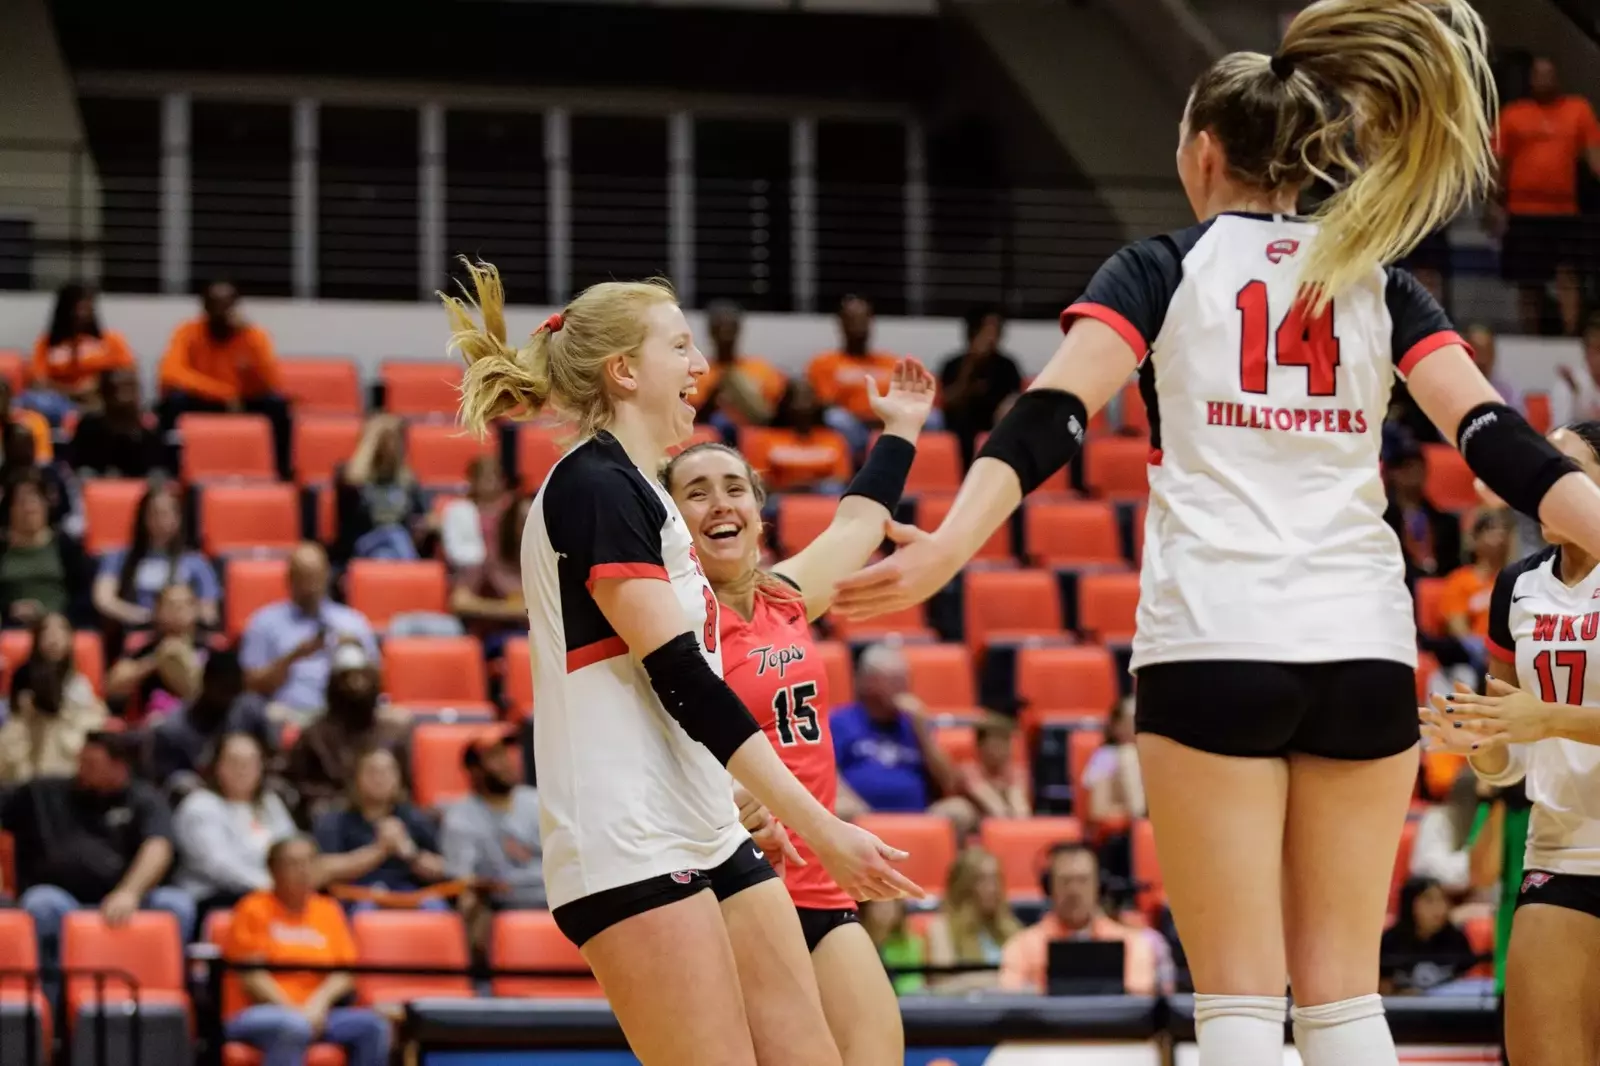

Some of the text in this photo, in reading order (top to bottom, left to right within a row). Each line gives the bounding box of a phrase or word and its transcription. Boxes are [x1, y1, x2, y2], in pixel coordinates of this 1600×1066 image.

[1236, 279, 1341, 397] 14
[1207, 401, 1368, 434] HILLTOPPERS
[702, 584, 718, 654] 8
[1532, 611, 1600, 642] WKU
[749, 644, 805, 680] Tops
[1533, 649, 1587, 706] 17
[771, 680, 822, 748] 15
